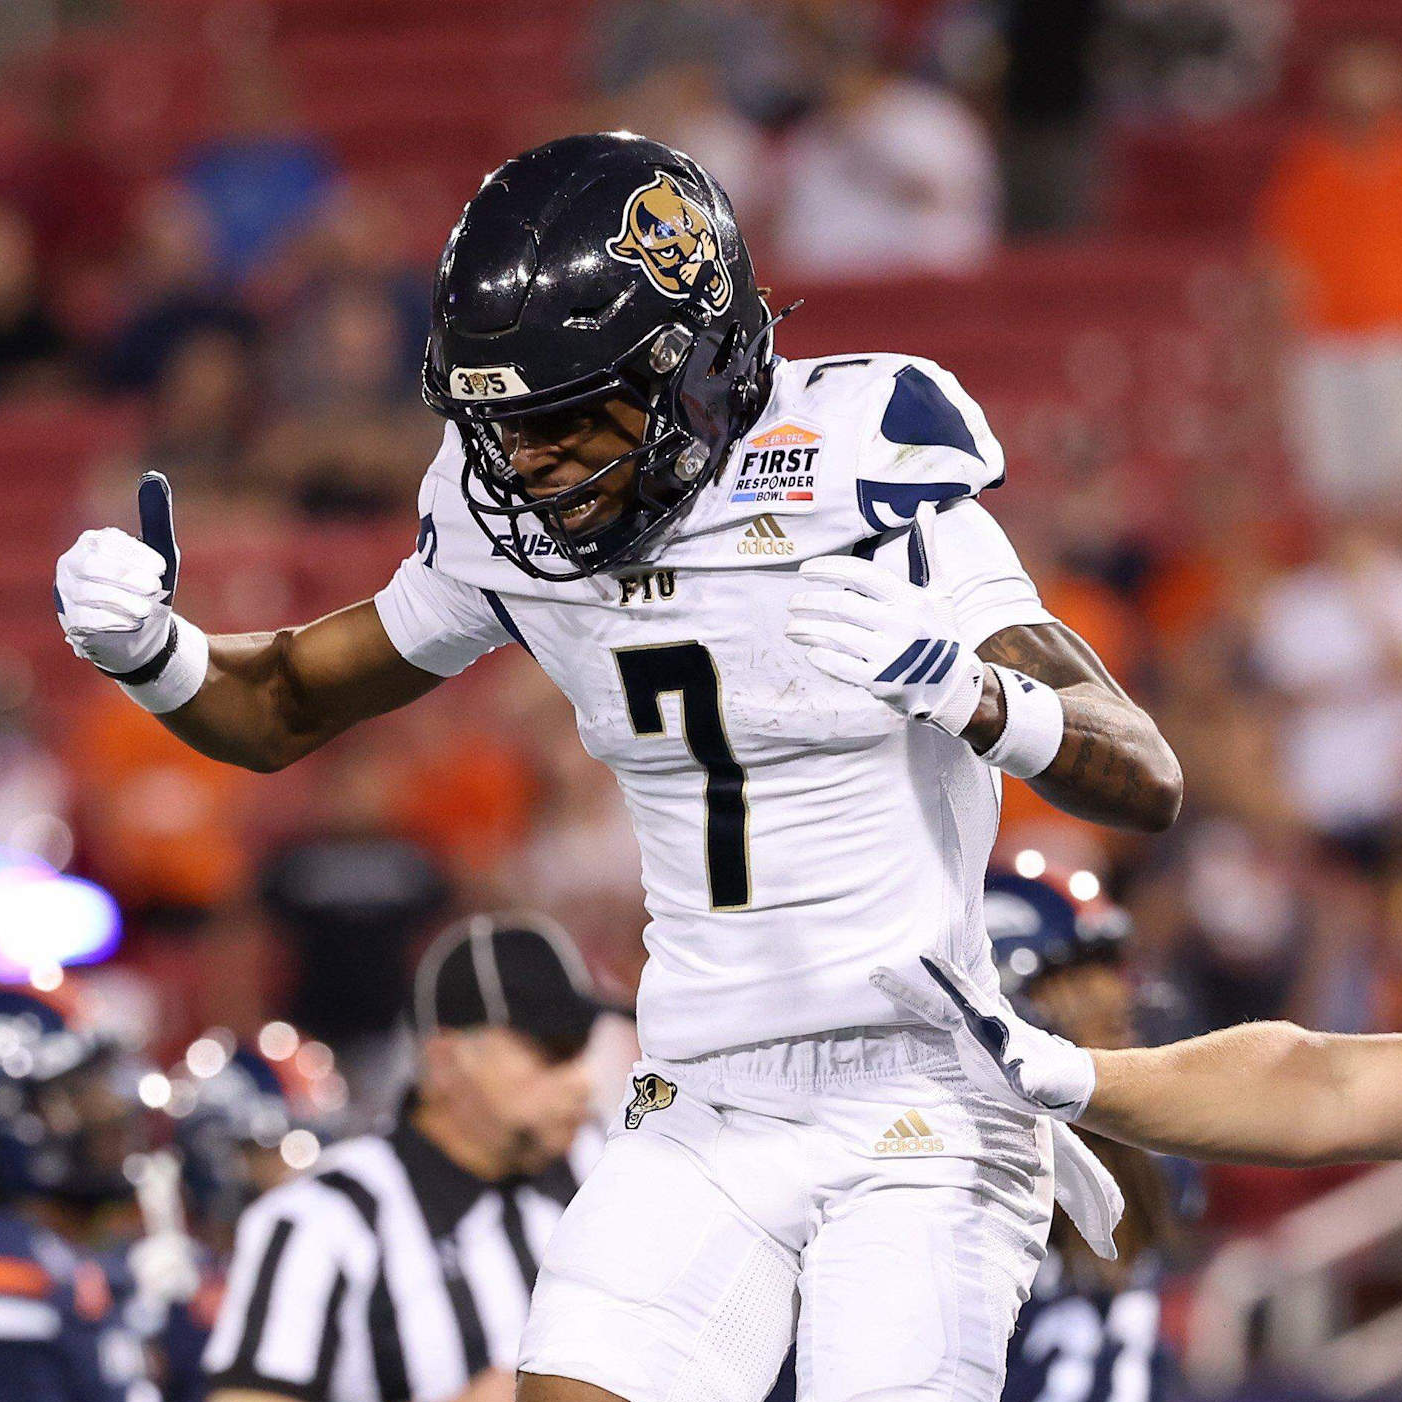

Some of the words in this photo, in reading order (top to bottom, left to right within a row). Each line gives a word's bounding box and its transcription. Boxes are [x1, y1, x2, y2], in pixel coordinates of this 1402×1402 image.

[735, 475, 814, 491] RESPONDER
[756, 490, 785, 501] BOWL
[736, 536, 795, 556] adidas
[618, 567, 678, 607] FIU
[610, 639, 753, 913] 7
[874, 1136, 945, 1154] adidas
